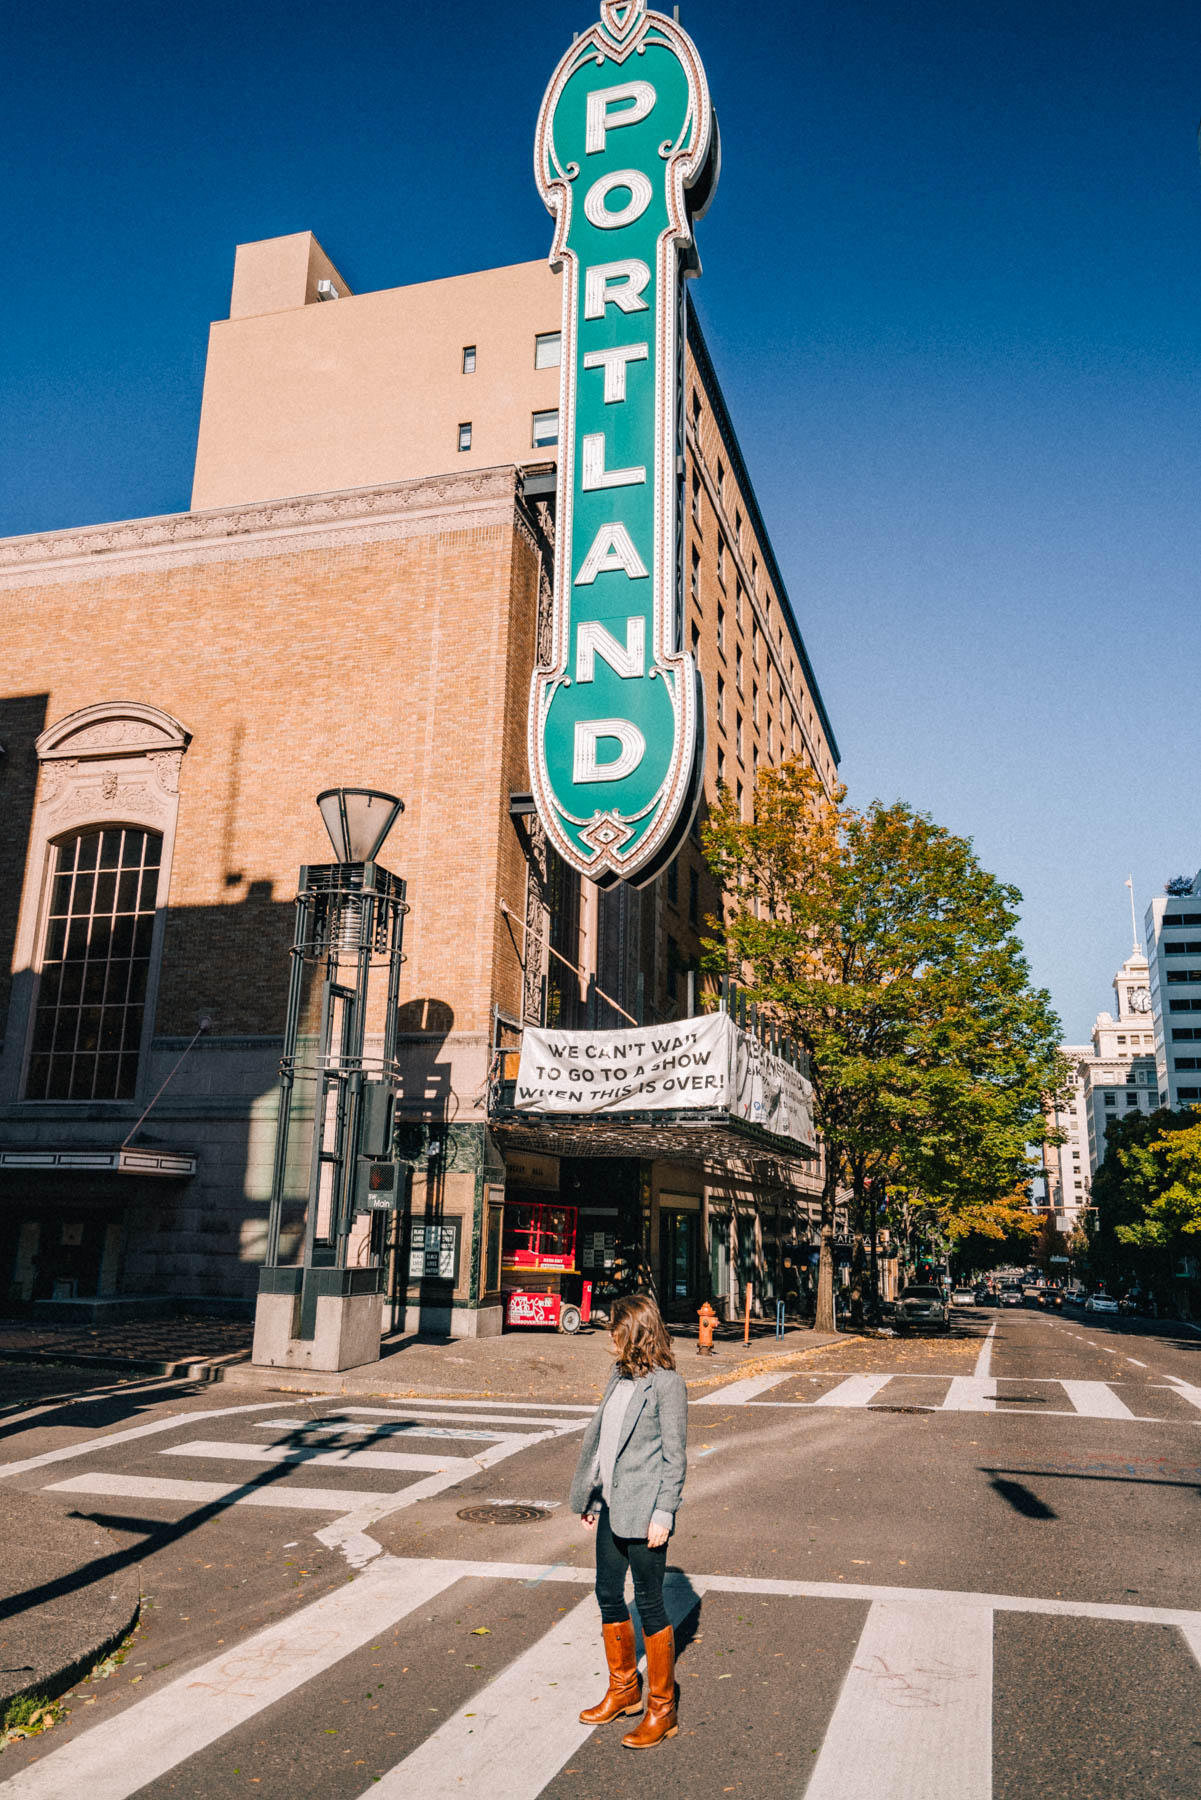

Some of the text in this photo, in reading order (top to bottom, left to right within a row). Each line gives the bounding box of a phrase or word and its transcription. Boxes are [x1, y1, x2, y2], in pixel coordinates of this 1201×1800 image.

[573, 80, 656, 784] PORTLAND
[548, 1044, 579, 1059] WE
[585, 1043, 645, 1059] CAN'T
[536, 1050, 711, 1082] TO GO TO A SHOW
[590, 1085, 633, 1100] THIS
[638, 1080, 657, 1093] IS
[663, 1074, 724, 1091] OVER!
[373, 1200, 390, 1208] Main
